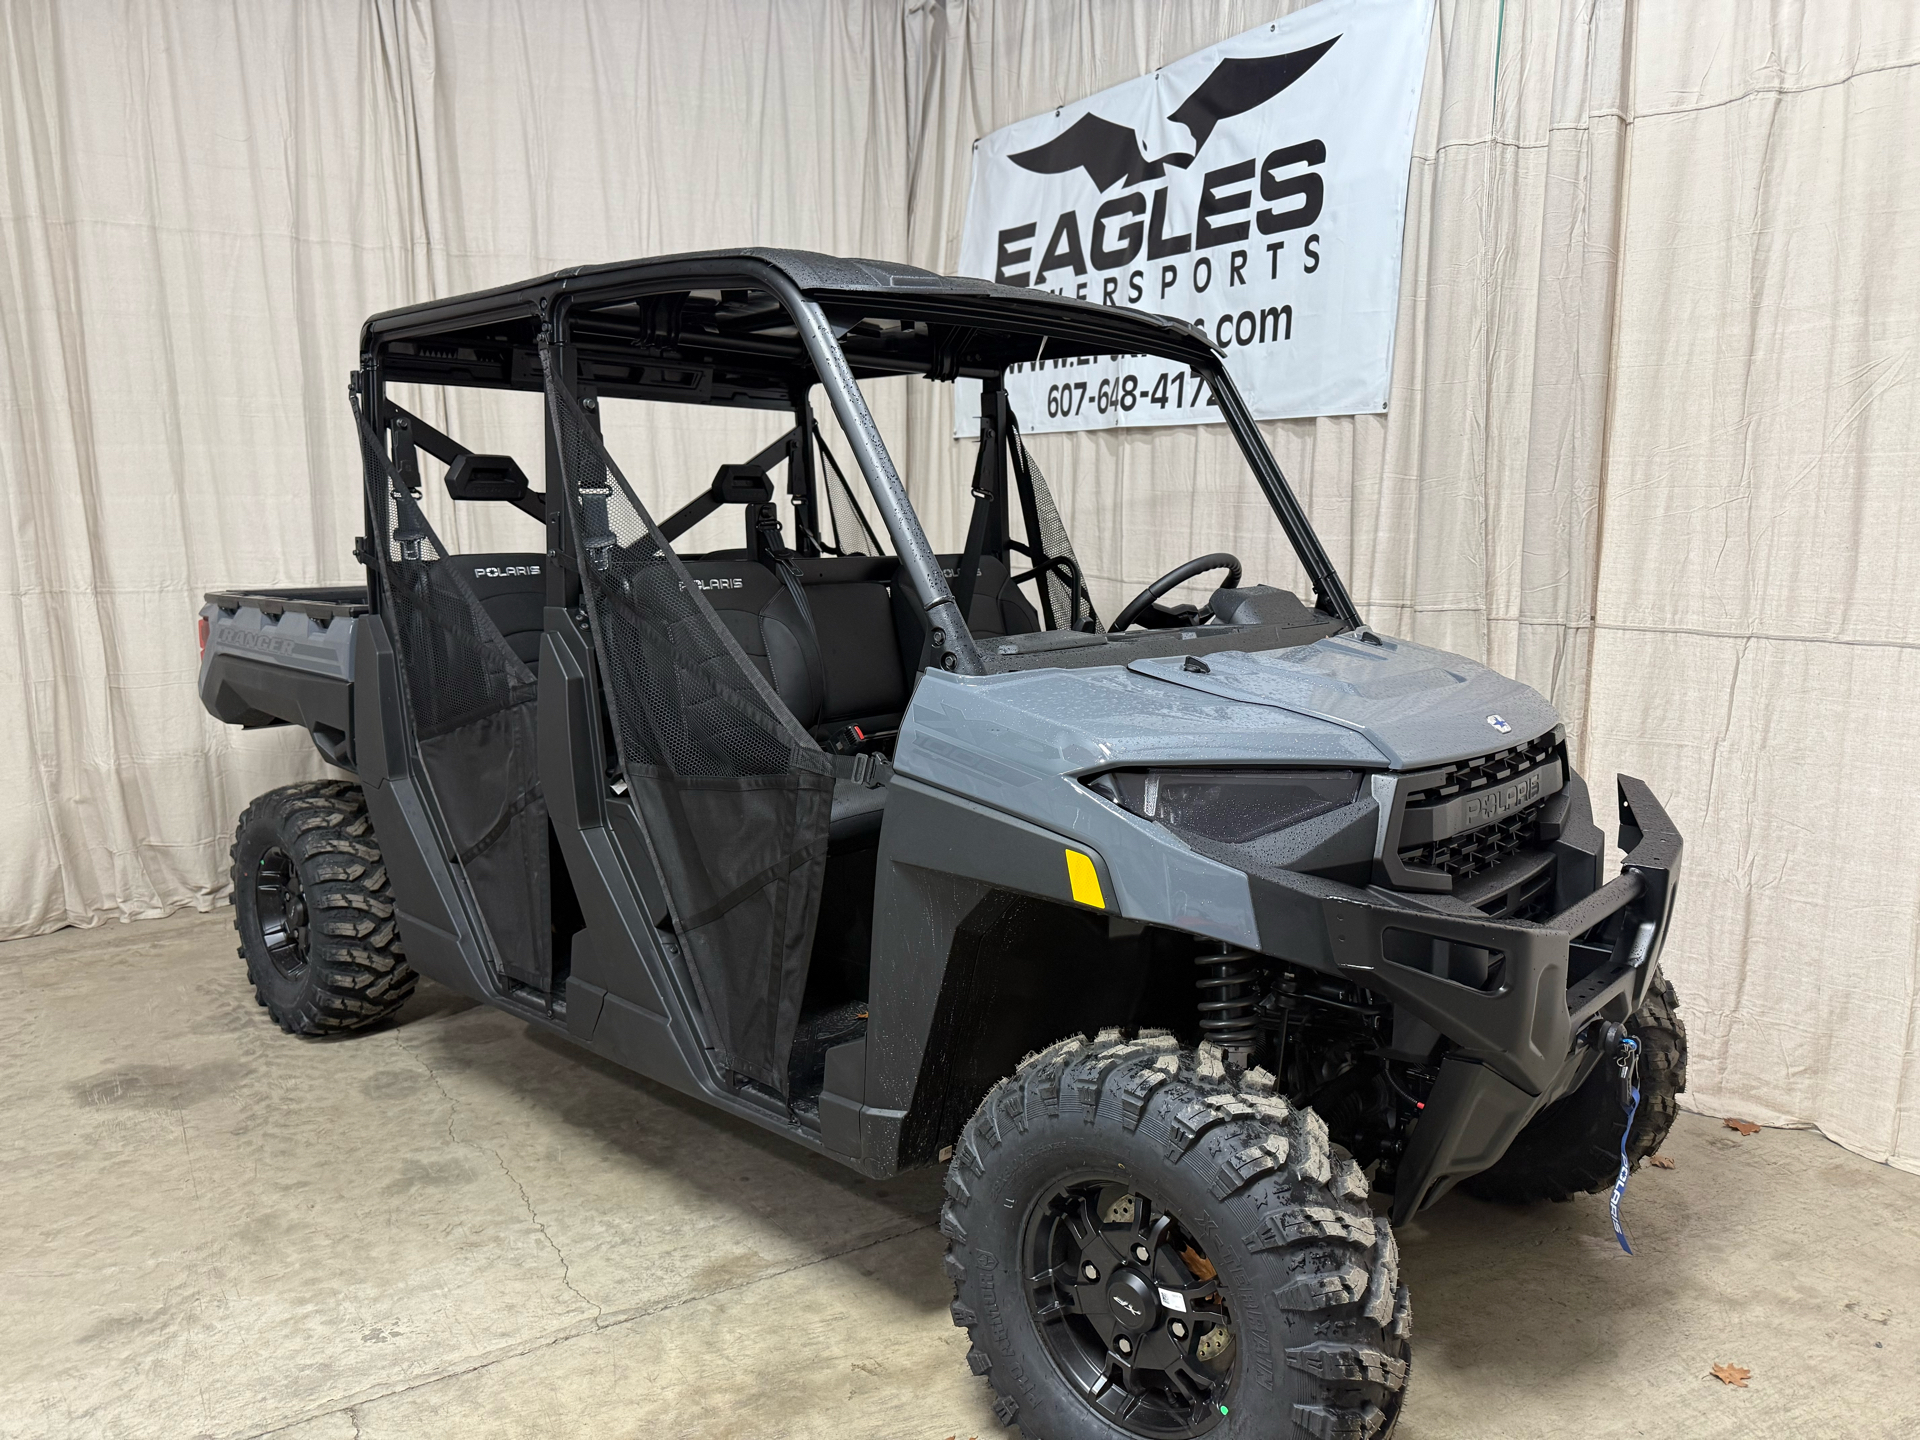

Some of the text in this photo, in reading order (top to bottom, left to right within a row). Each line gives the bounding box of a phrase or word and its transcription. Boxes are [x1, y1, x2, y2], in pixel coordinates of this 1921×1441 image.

[995, 139, 1326, 287] EAGLES
[1050, 234, 1321, 306] ERSPORTS
[474, 564, 541, 578] POLARIS
[219, 627, 296, 654] RANGER
[1466, 774, 1541, 823] POLARIS
[1610, 1152, 1629, 1234] POLARIS
